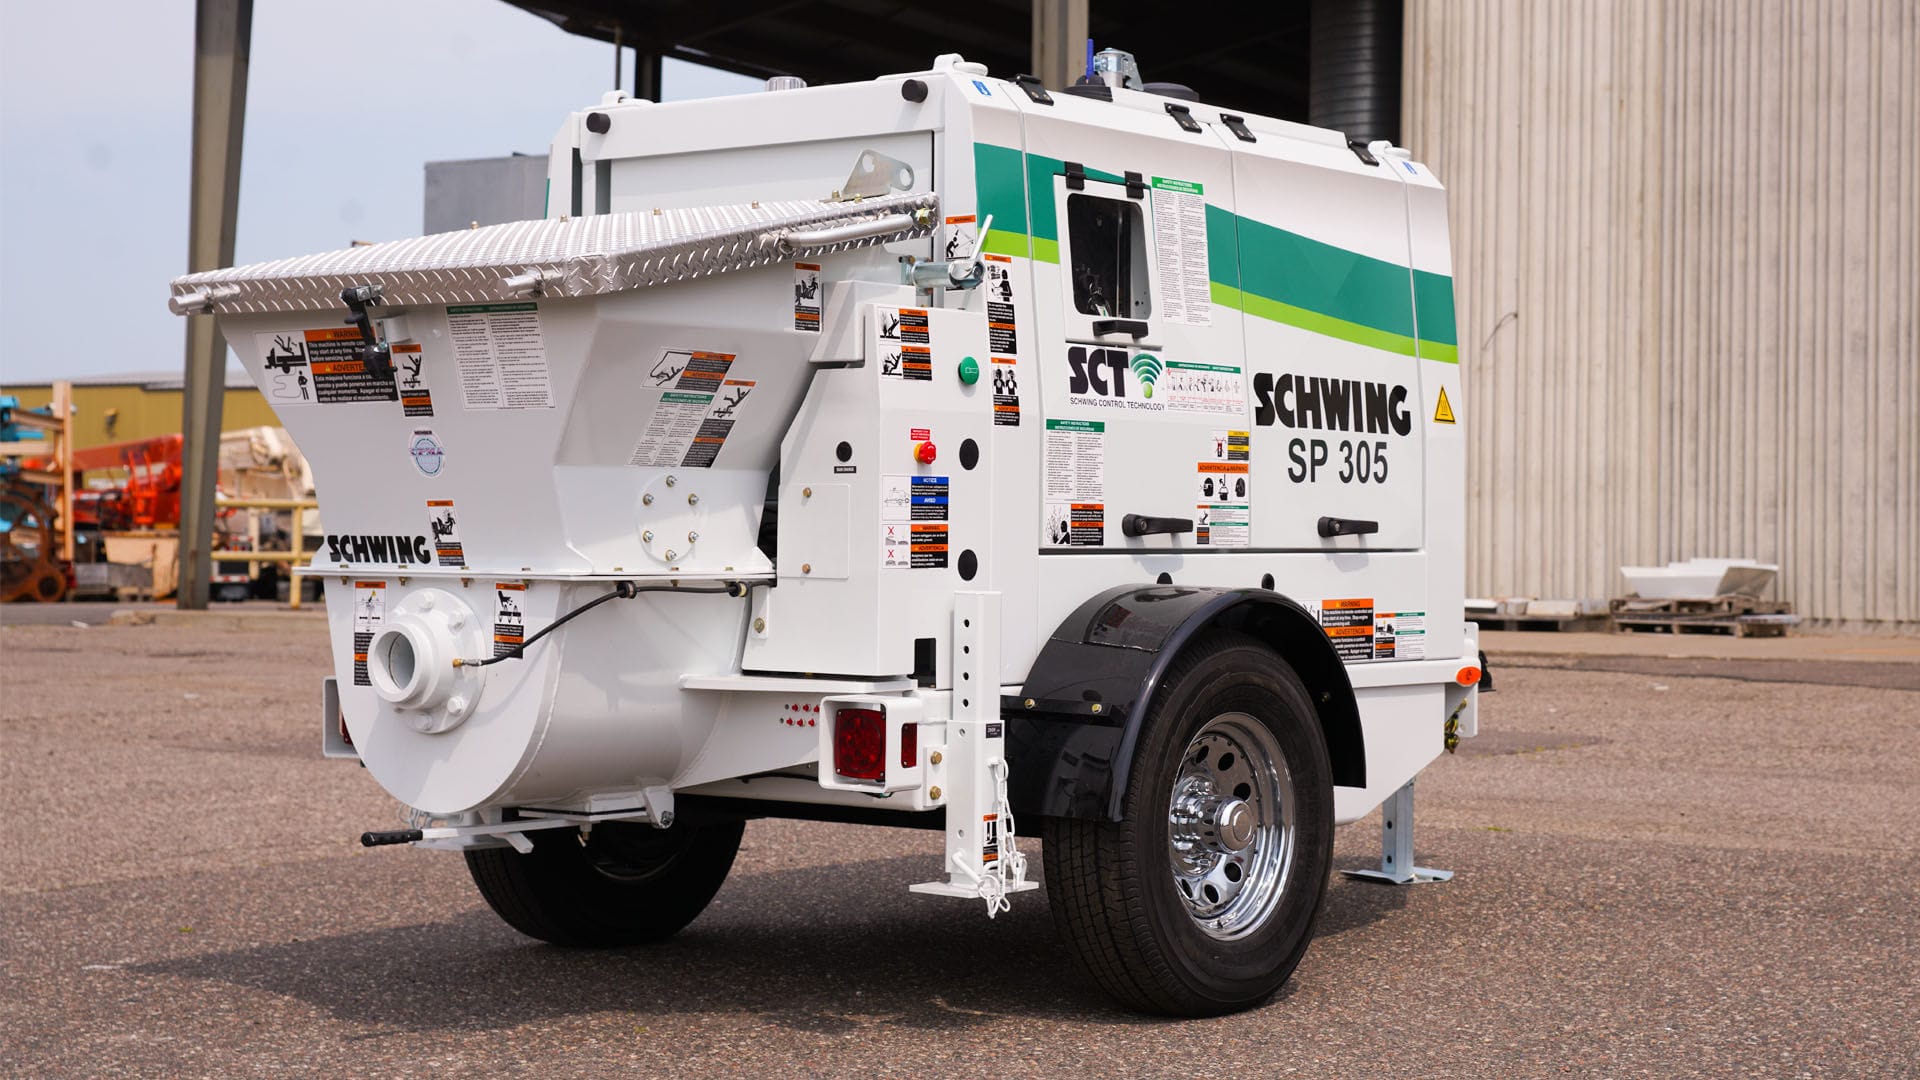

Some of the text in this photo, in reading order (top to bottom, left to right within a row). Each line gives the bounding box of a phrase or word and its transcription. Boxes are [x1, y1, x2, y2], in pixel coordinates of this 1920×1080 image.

[334, 328, 360, 337] WARNIN
[1068, 346, 1129, 397] SCT
[1099, 399, 1126, 408] CONTROL
[1127, 401, 1165, 411] TECHNOLOGY
[1254, 372, 1411, 436] SCHWING
[1288, 438, 1328, 484] SP
[1339, 440, 1388, 484] 305
[328, 535, 431, 564] SCHWING
